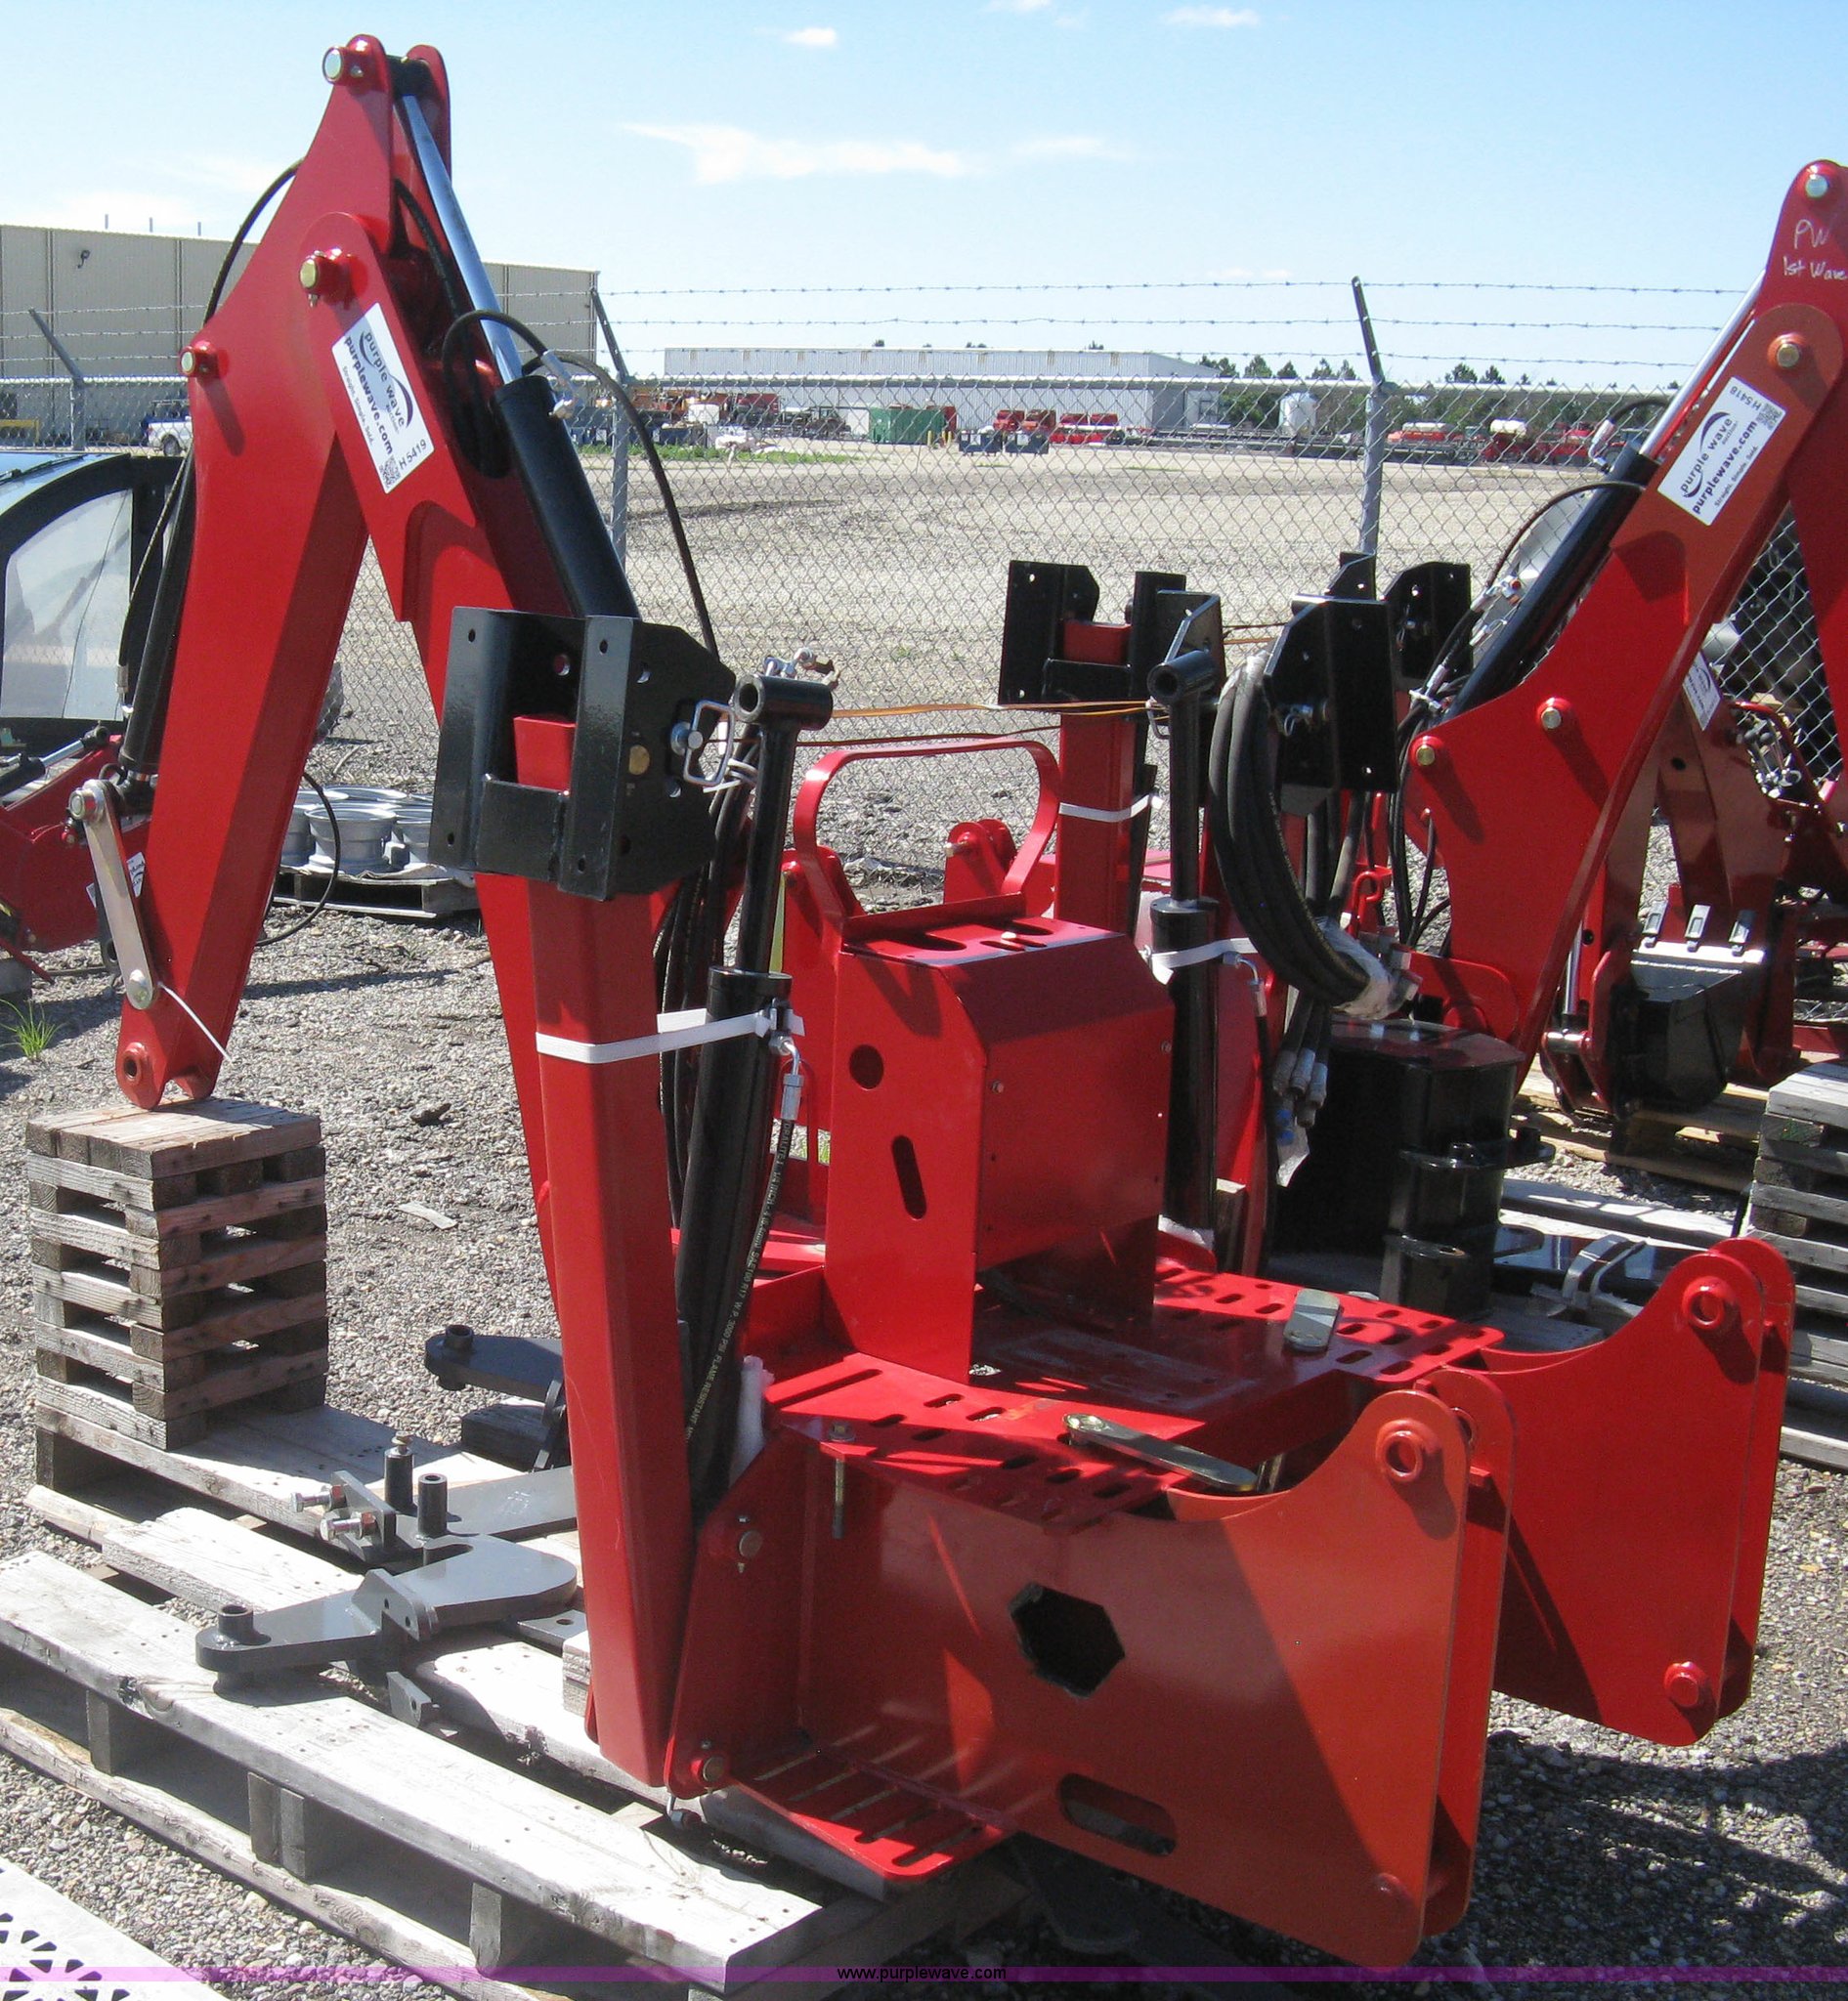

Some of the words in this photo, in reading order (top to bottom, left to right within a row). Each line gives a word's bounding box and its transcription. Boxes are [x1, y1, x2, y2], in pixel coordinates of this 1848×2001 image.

[1793, 219, 1829, 249] PW
[344, 336, 393, 454] purplewave.com
[364, 331, 388, 382] purple
[386, 387, 406, 428] wave
[1679, 451, 1709, 493] purple
[1707, 417, 1733, 450] wave
[1692, 420, 1758, 515] purplewave.com
[737, 1282, 748, 1298] R17
[717, 1338, 728, 1352] PSI
[722, 1319, 735, 1338] 3000
[706, 1353, 723, 1382] FLAME
[688, 1381, 711, 1424] RESISTANT
